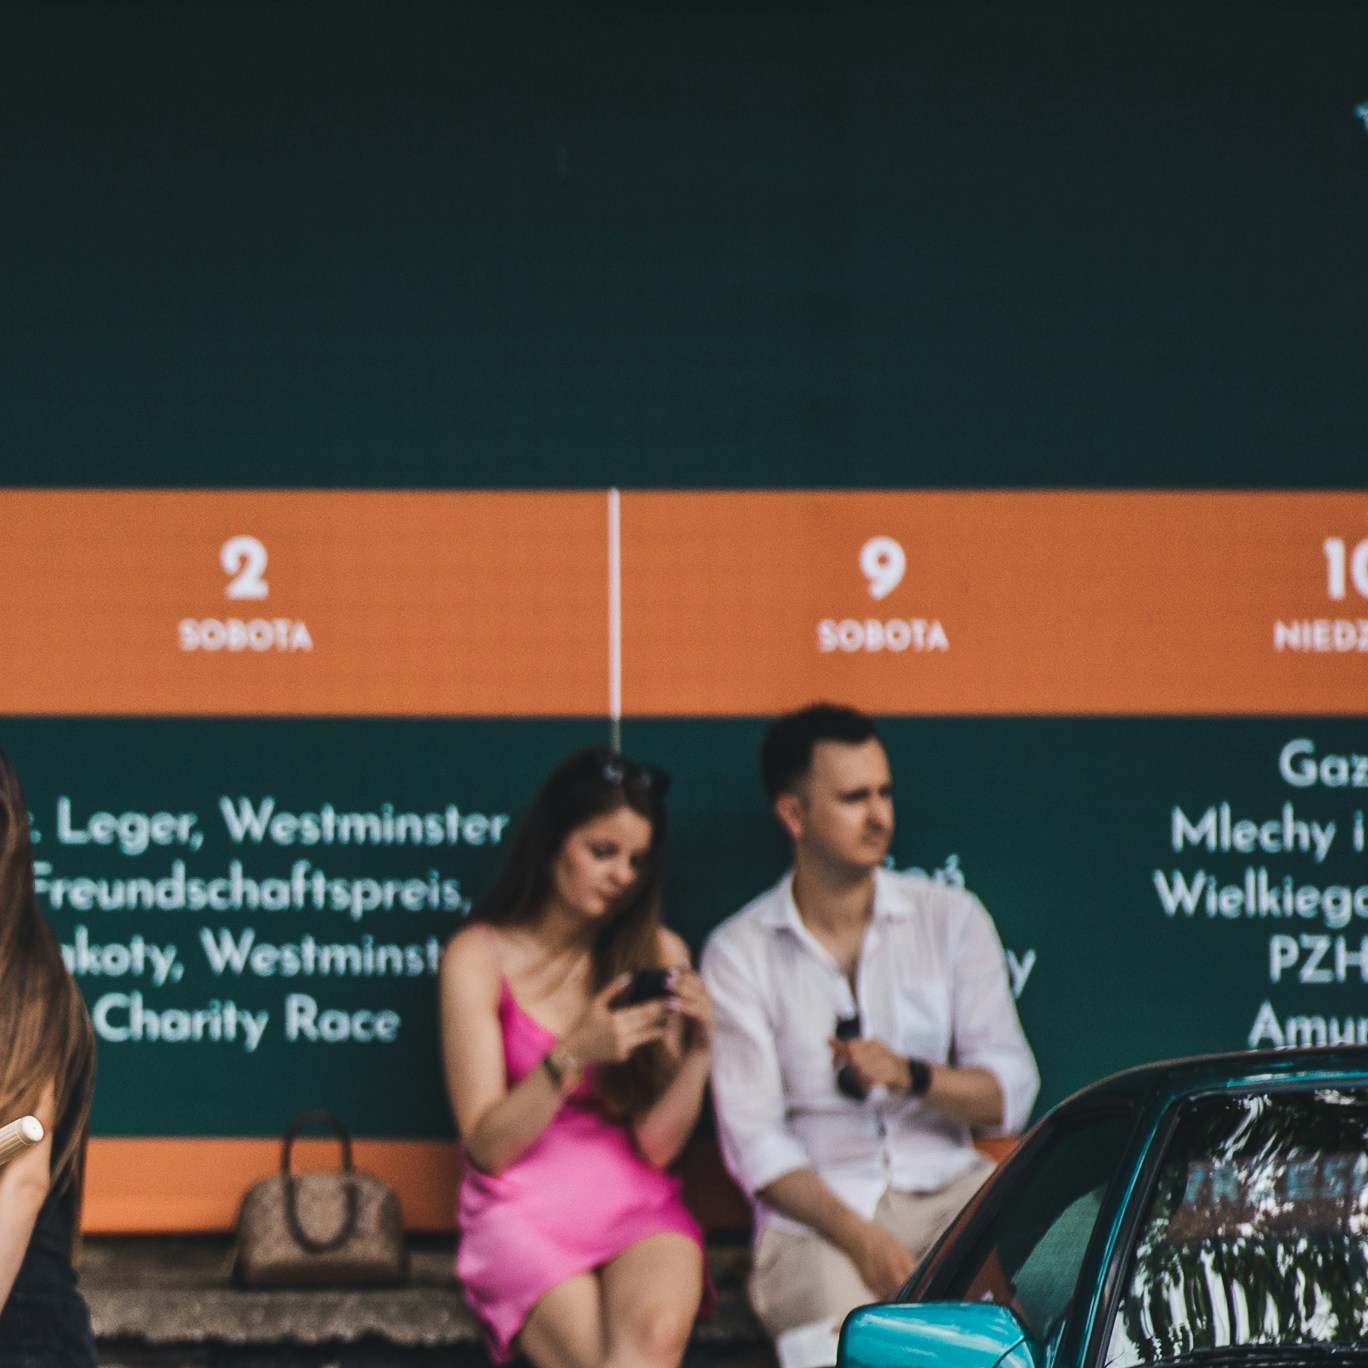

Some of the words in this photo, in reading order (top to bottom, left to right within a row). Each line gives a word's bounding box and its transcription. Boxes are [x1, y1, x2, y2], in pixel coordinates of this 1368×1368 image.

[219, 534, 270, 601] 2
[858, 535, 908, 601] 9
[178, 617, 314, 653] SOBOTA
[816, 617, 950, 653] SOBOTA
[57, 796, 203, 855] Leger,
[219, 796, 510, 845] Westminster
[1171, 801, 1336, 862] Mlechy
[91, 992, 270, 1051] Charity
[284, 992, 401, 1042] Race
